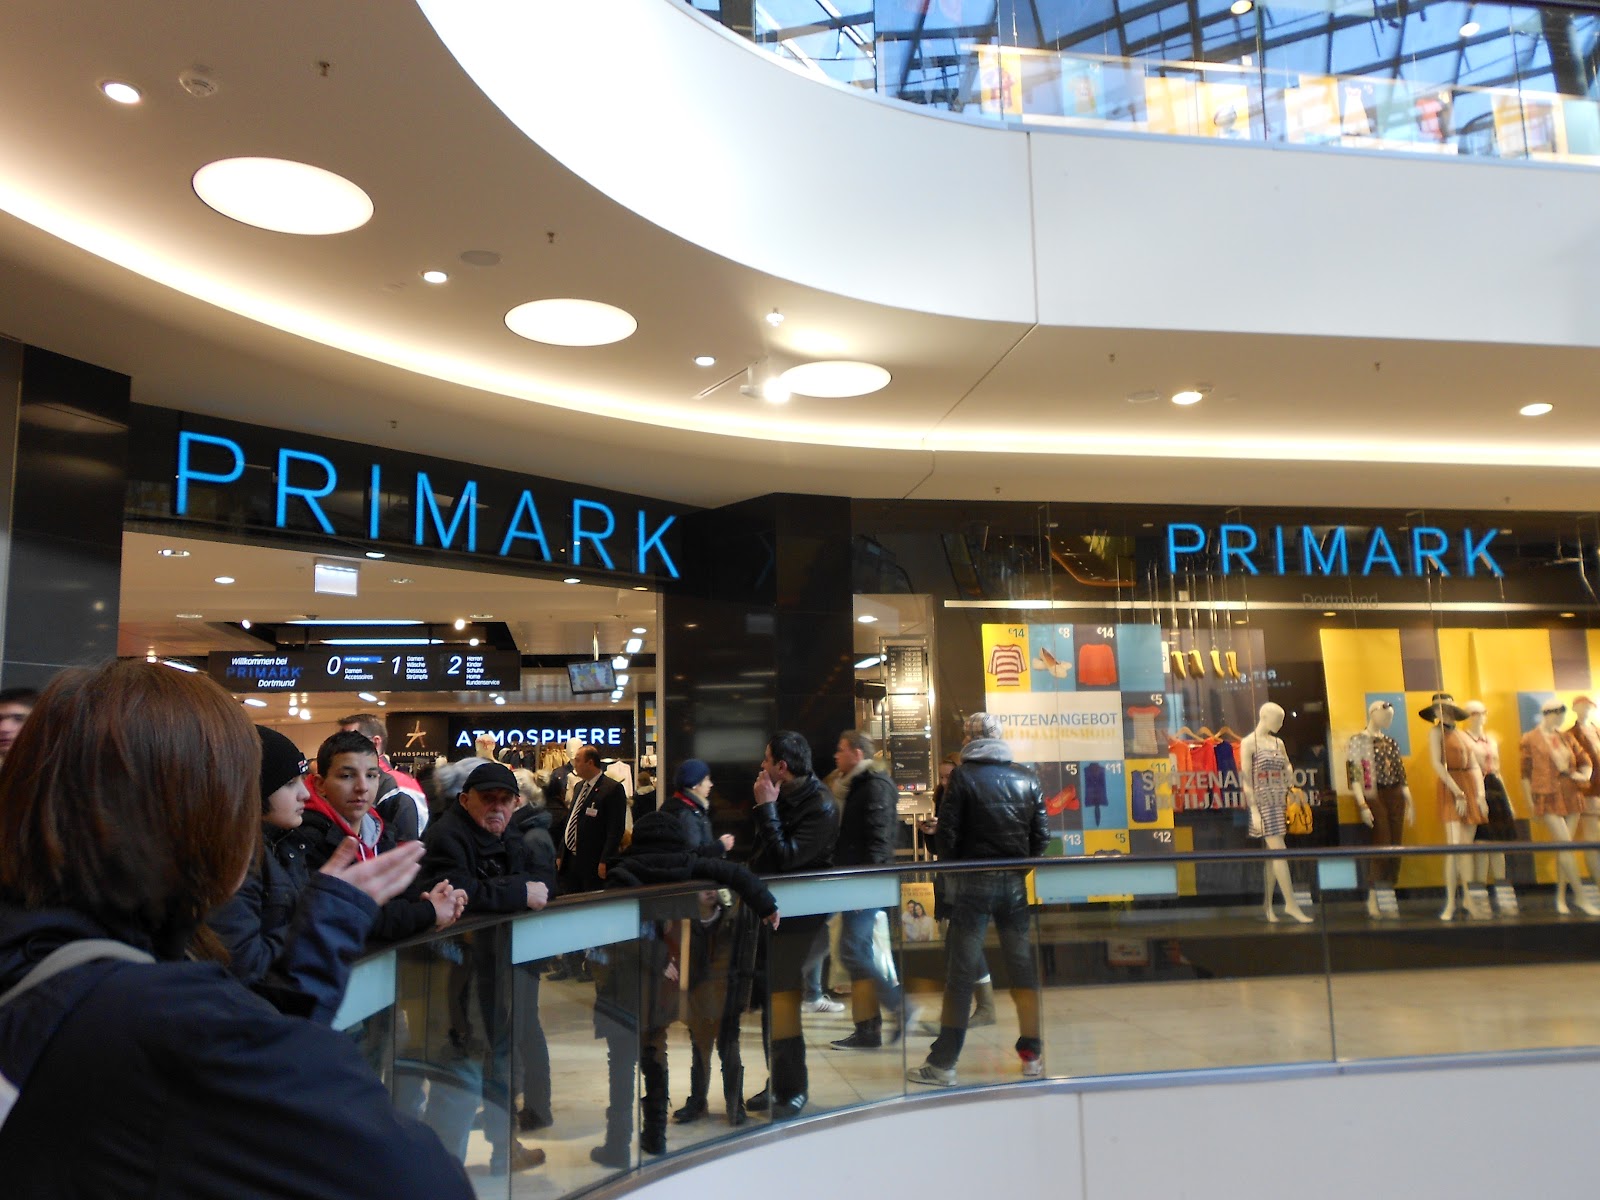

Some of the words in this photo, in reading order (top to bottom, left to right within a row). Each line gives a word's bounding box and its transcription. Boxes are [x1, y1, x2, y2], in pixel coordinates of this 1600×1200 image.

[176, 431, 680, 579] PRIMARK
[1166, 523, 1503, 577] PRIMARK
[1302, 593, 1378, 609] Dortmund
[1058, 627, 1070, 638] €8
[1097, 627, 1114, 639] €14
[231, 657, 274, 666] Willkommen
[275, 657, 288, 665] bei
[327, 656, 341, 674] 0
[391, 656, 401, 674] 1
[447, 655, 462, 674] 2
[226, 667, 302, 678] PRIMARK
[258, 679, 296, 687] Dortmund
[1150, 694, 1163, 705] €5
[999, 712, 1118, 727] PITZENANGEBOT
[1065, 764, 1078, 775] €5
